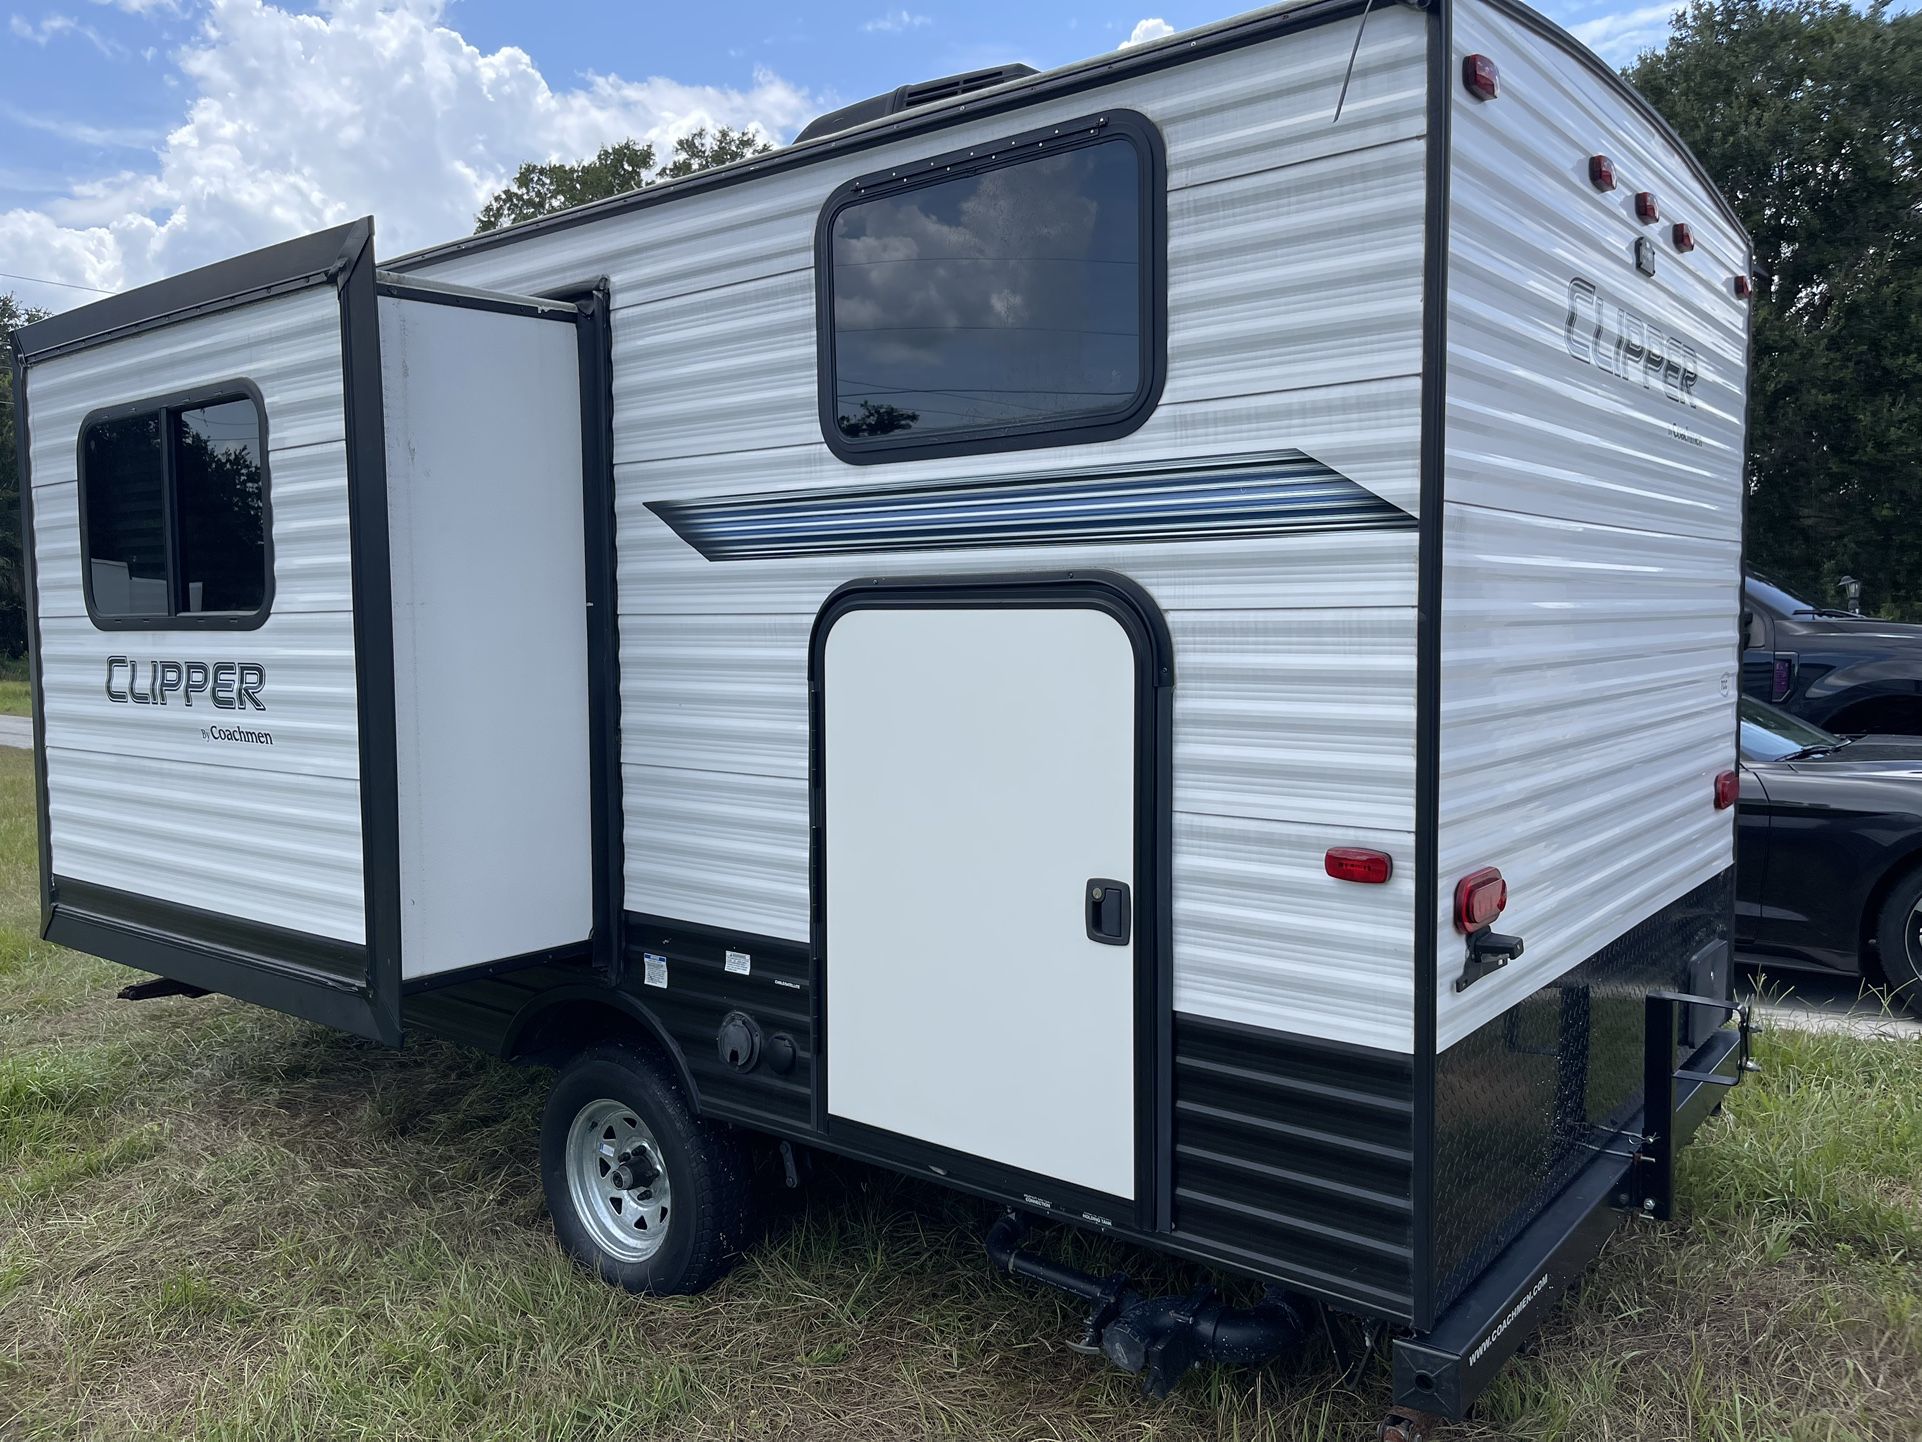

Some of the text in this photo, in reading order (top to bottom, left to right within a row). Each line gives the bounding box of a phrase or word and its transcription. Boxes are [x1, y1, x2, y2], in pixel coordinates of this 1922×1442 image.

[1564, 277, 1698, 409] CLIPPER
[105, 655, 266, 711] CLIPPER
[210, 725, 273, 745] Coachmen
[1469, 1273, 1548, 1367] WWW.COACHMEN.COM
